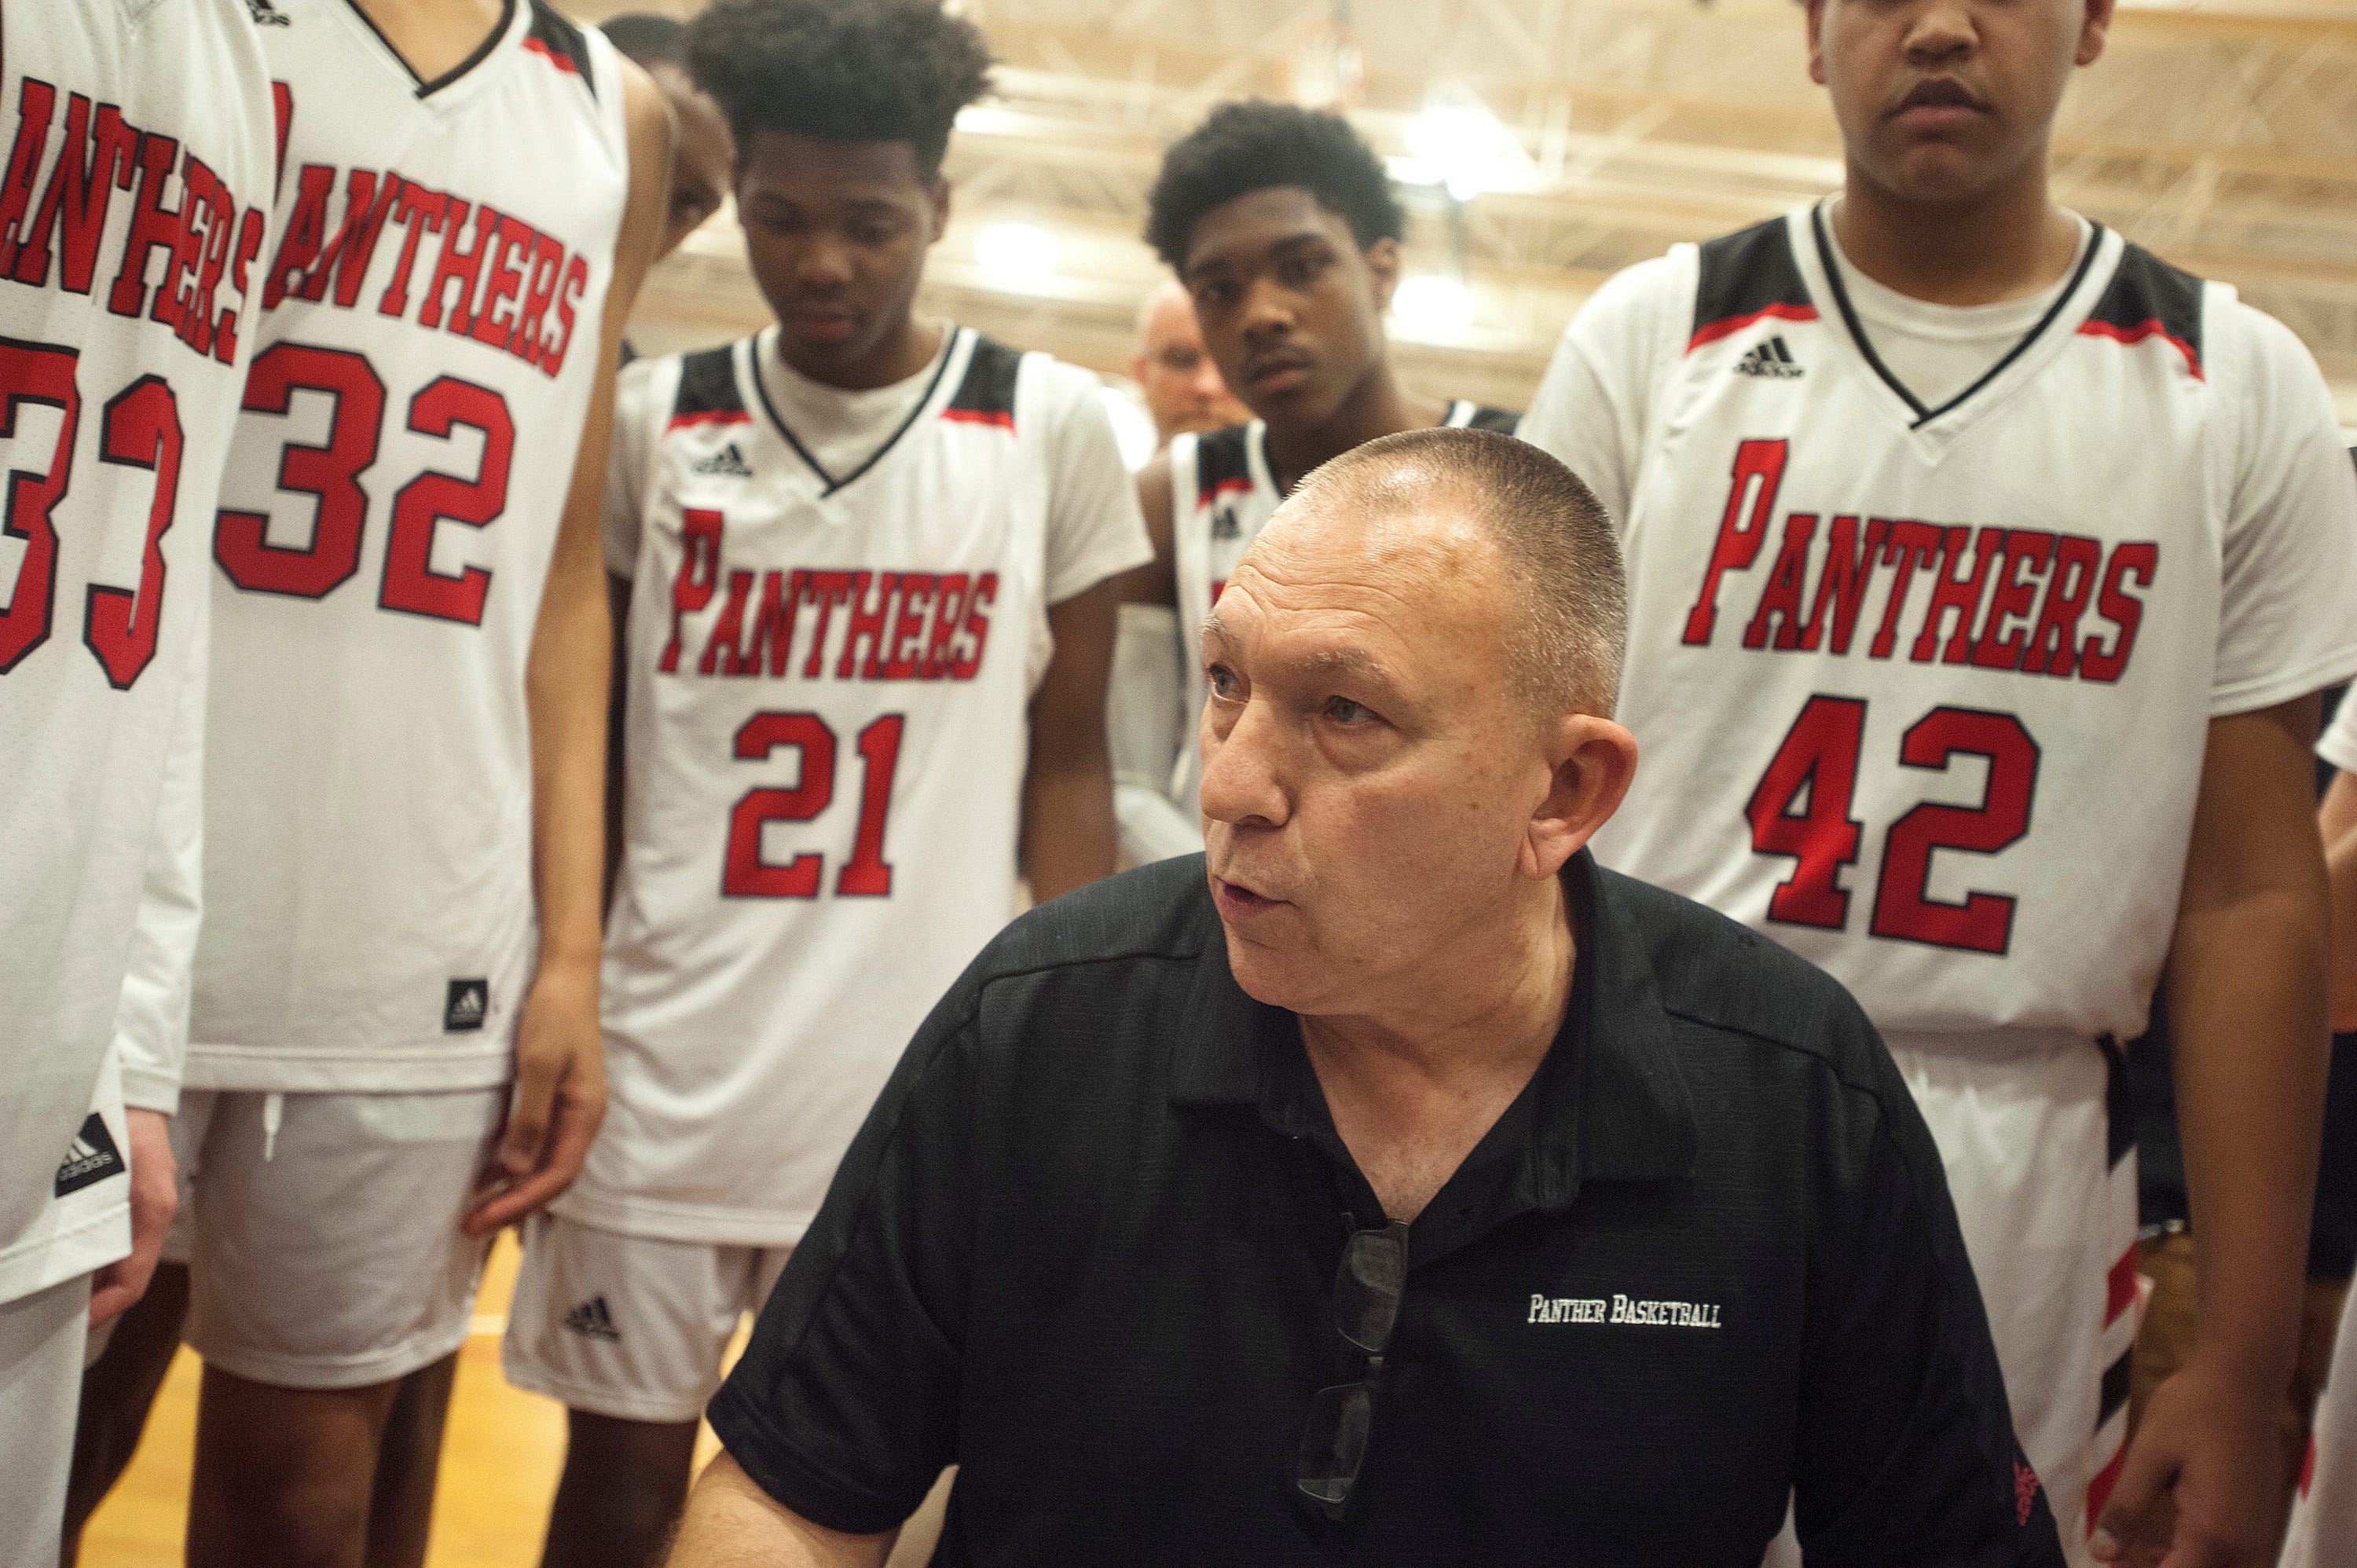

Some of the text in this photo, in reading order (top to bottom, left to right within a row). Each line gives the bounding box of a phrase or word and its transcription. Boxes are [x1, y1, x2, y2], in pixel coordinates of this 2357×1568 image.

[213, 341, 515, 627] 32
[1681, 438, 2158, 683] PANTHERS
[659, 508, 1000, 681] PANTHERS
[720, 711, 906, 899] 21
[1743, 694, 2040, 956] 42
[1527, 1294, 1721, 1328] PANTHER BASKETBALL
